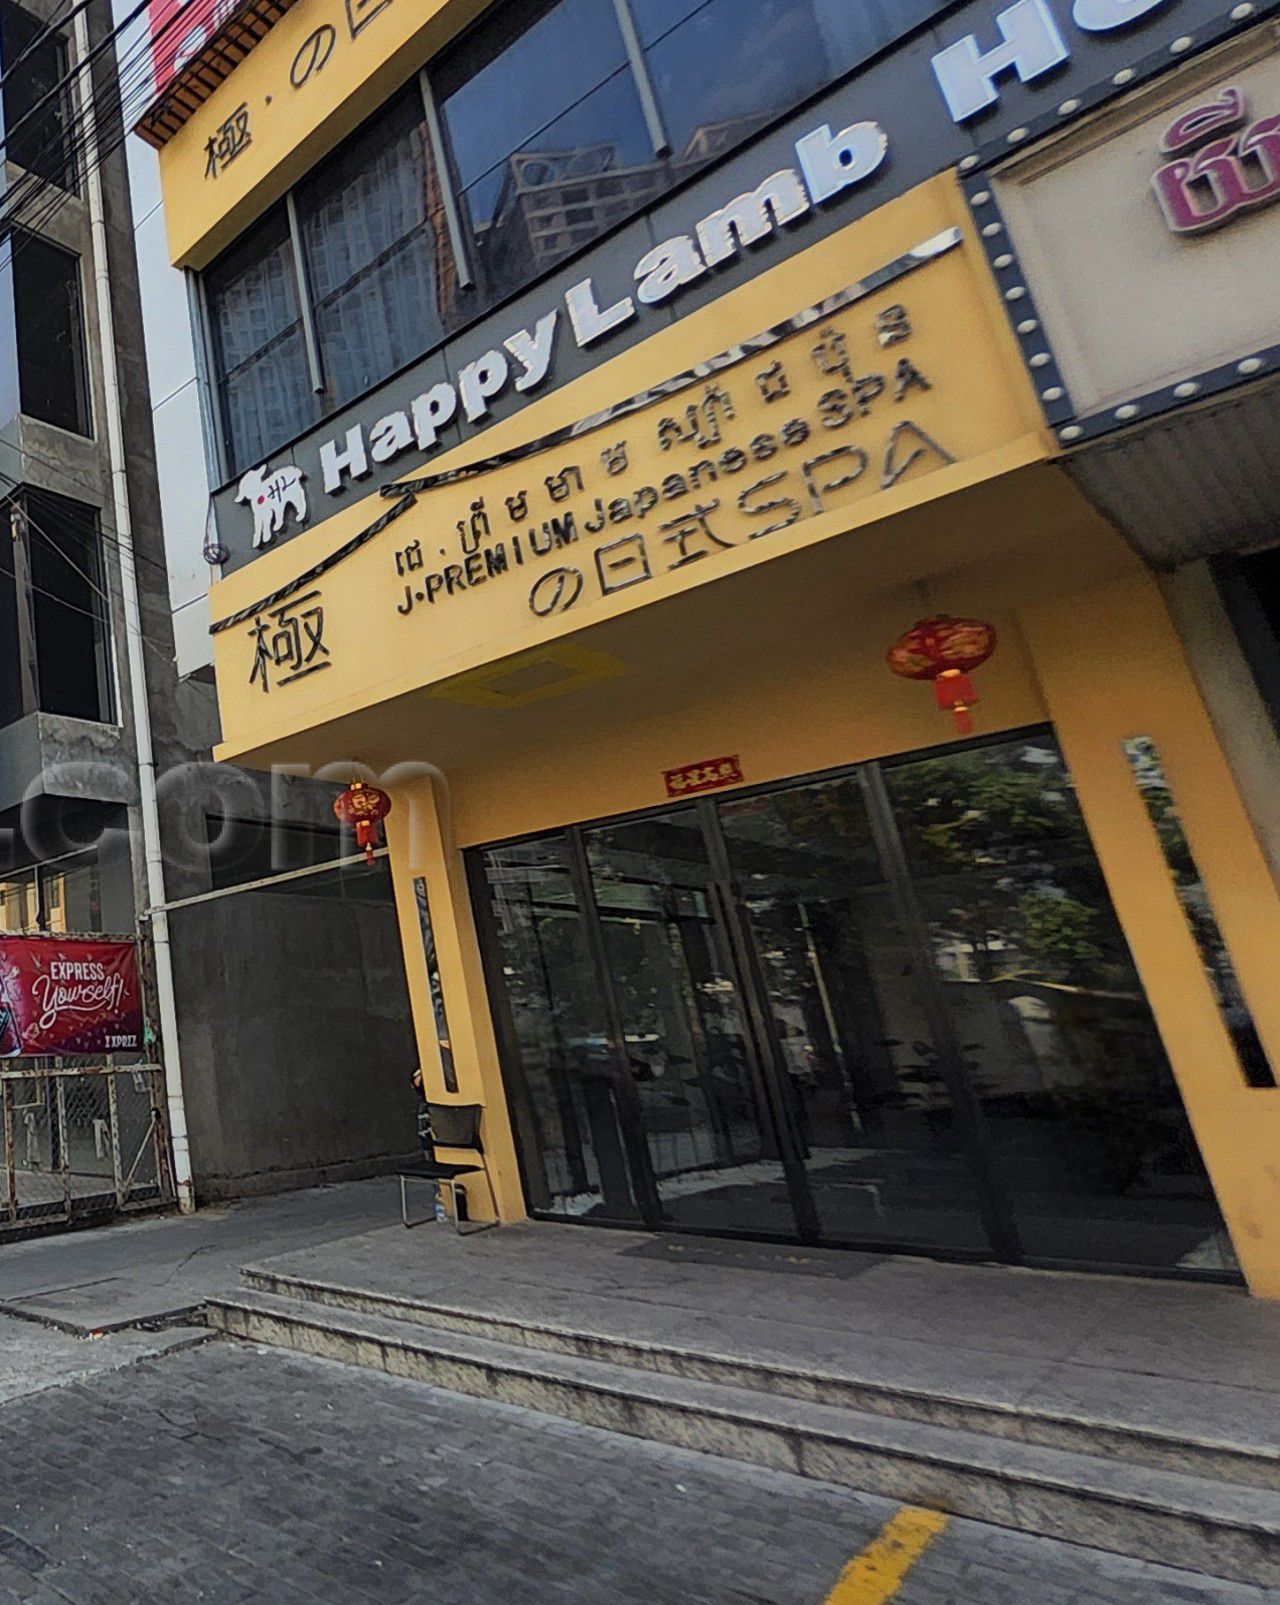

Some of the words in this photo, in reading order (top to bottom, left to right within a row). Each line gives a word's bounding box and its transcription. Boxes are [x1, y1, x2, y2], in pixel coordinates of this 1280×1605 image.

[817, 357, 932, 429] SPA
[247, 590, 332, 693] 極
[32, 972, 124, 1030] Yourself!
[50, 961, 105, 981] EXPRESS
